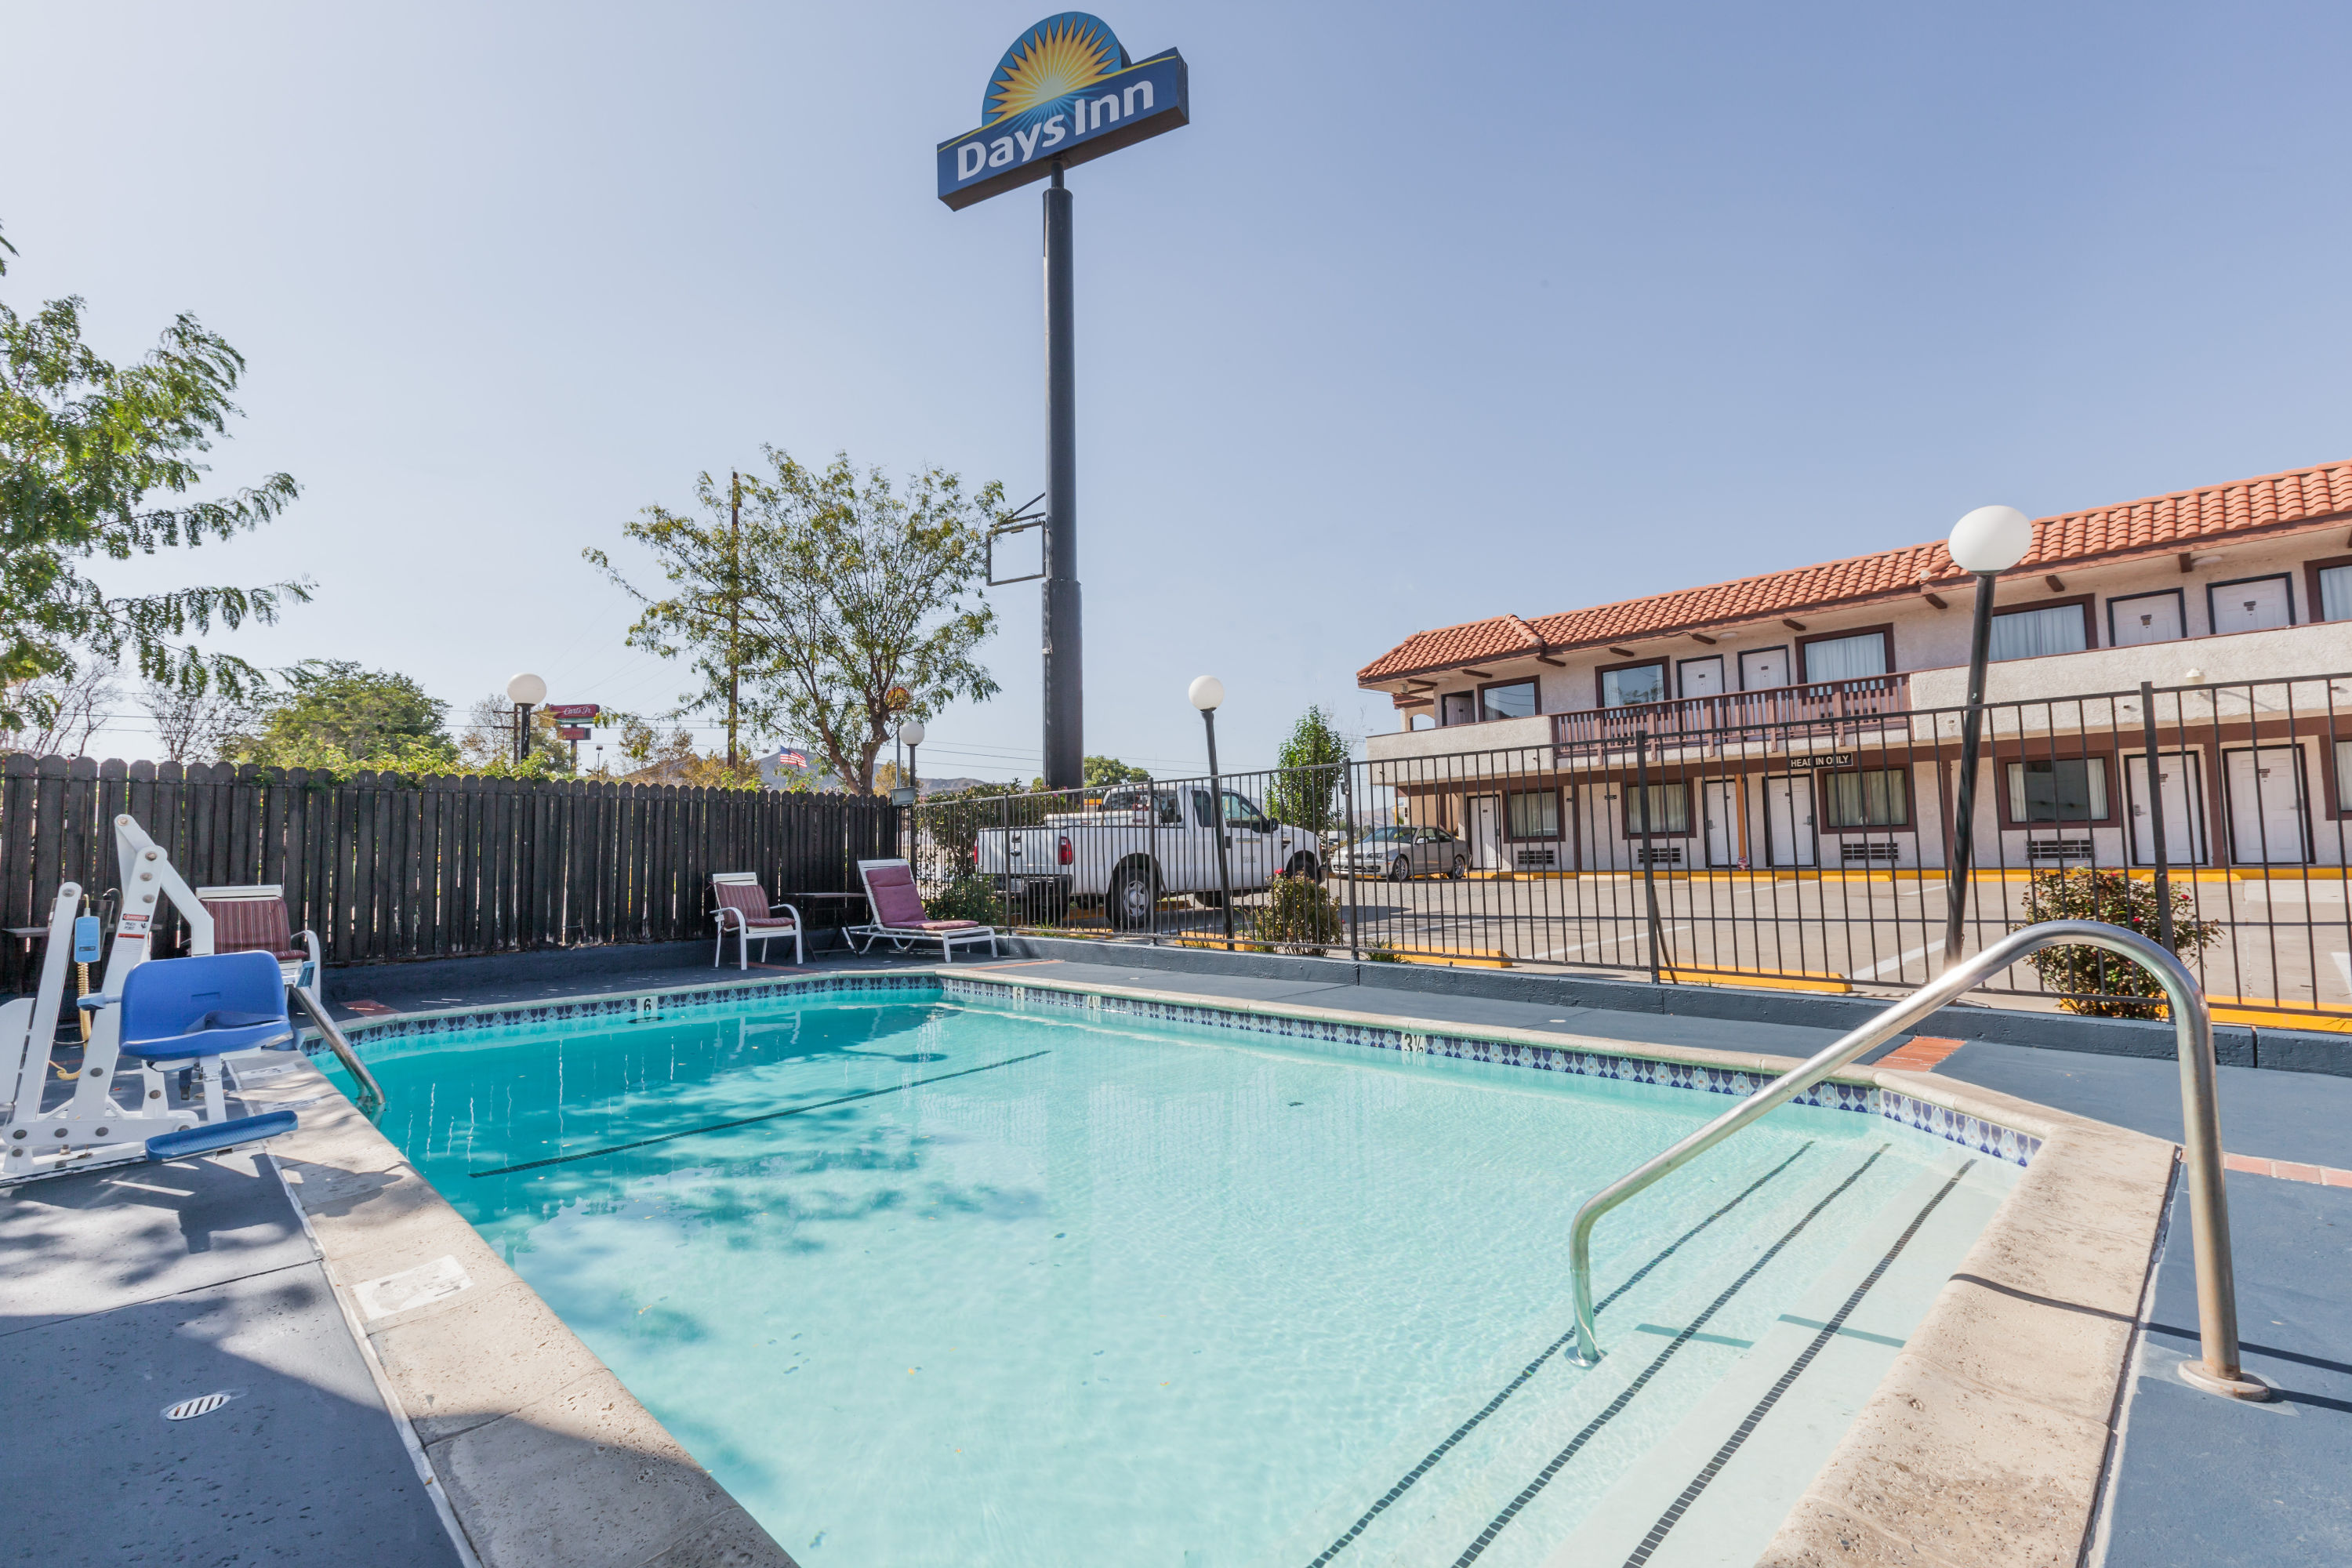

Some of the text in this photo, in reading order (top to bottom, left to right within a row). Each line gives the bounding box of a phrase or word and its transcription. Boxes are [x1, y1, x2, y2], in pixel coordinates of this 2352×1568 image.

[957, 79, 1154, 182] Days Inn
[1791, 758, 1813, 768] HEA
[1816, 757, 1824, 766] IN
[644, 998, 652, 1014] 6
